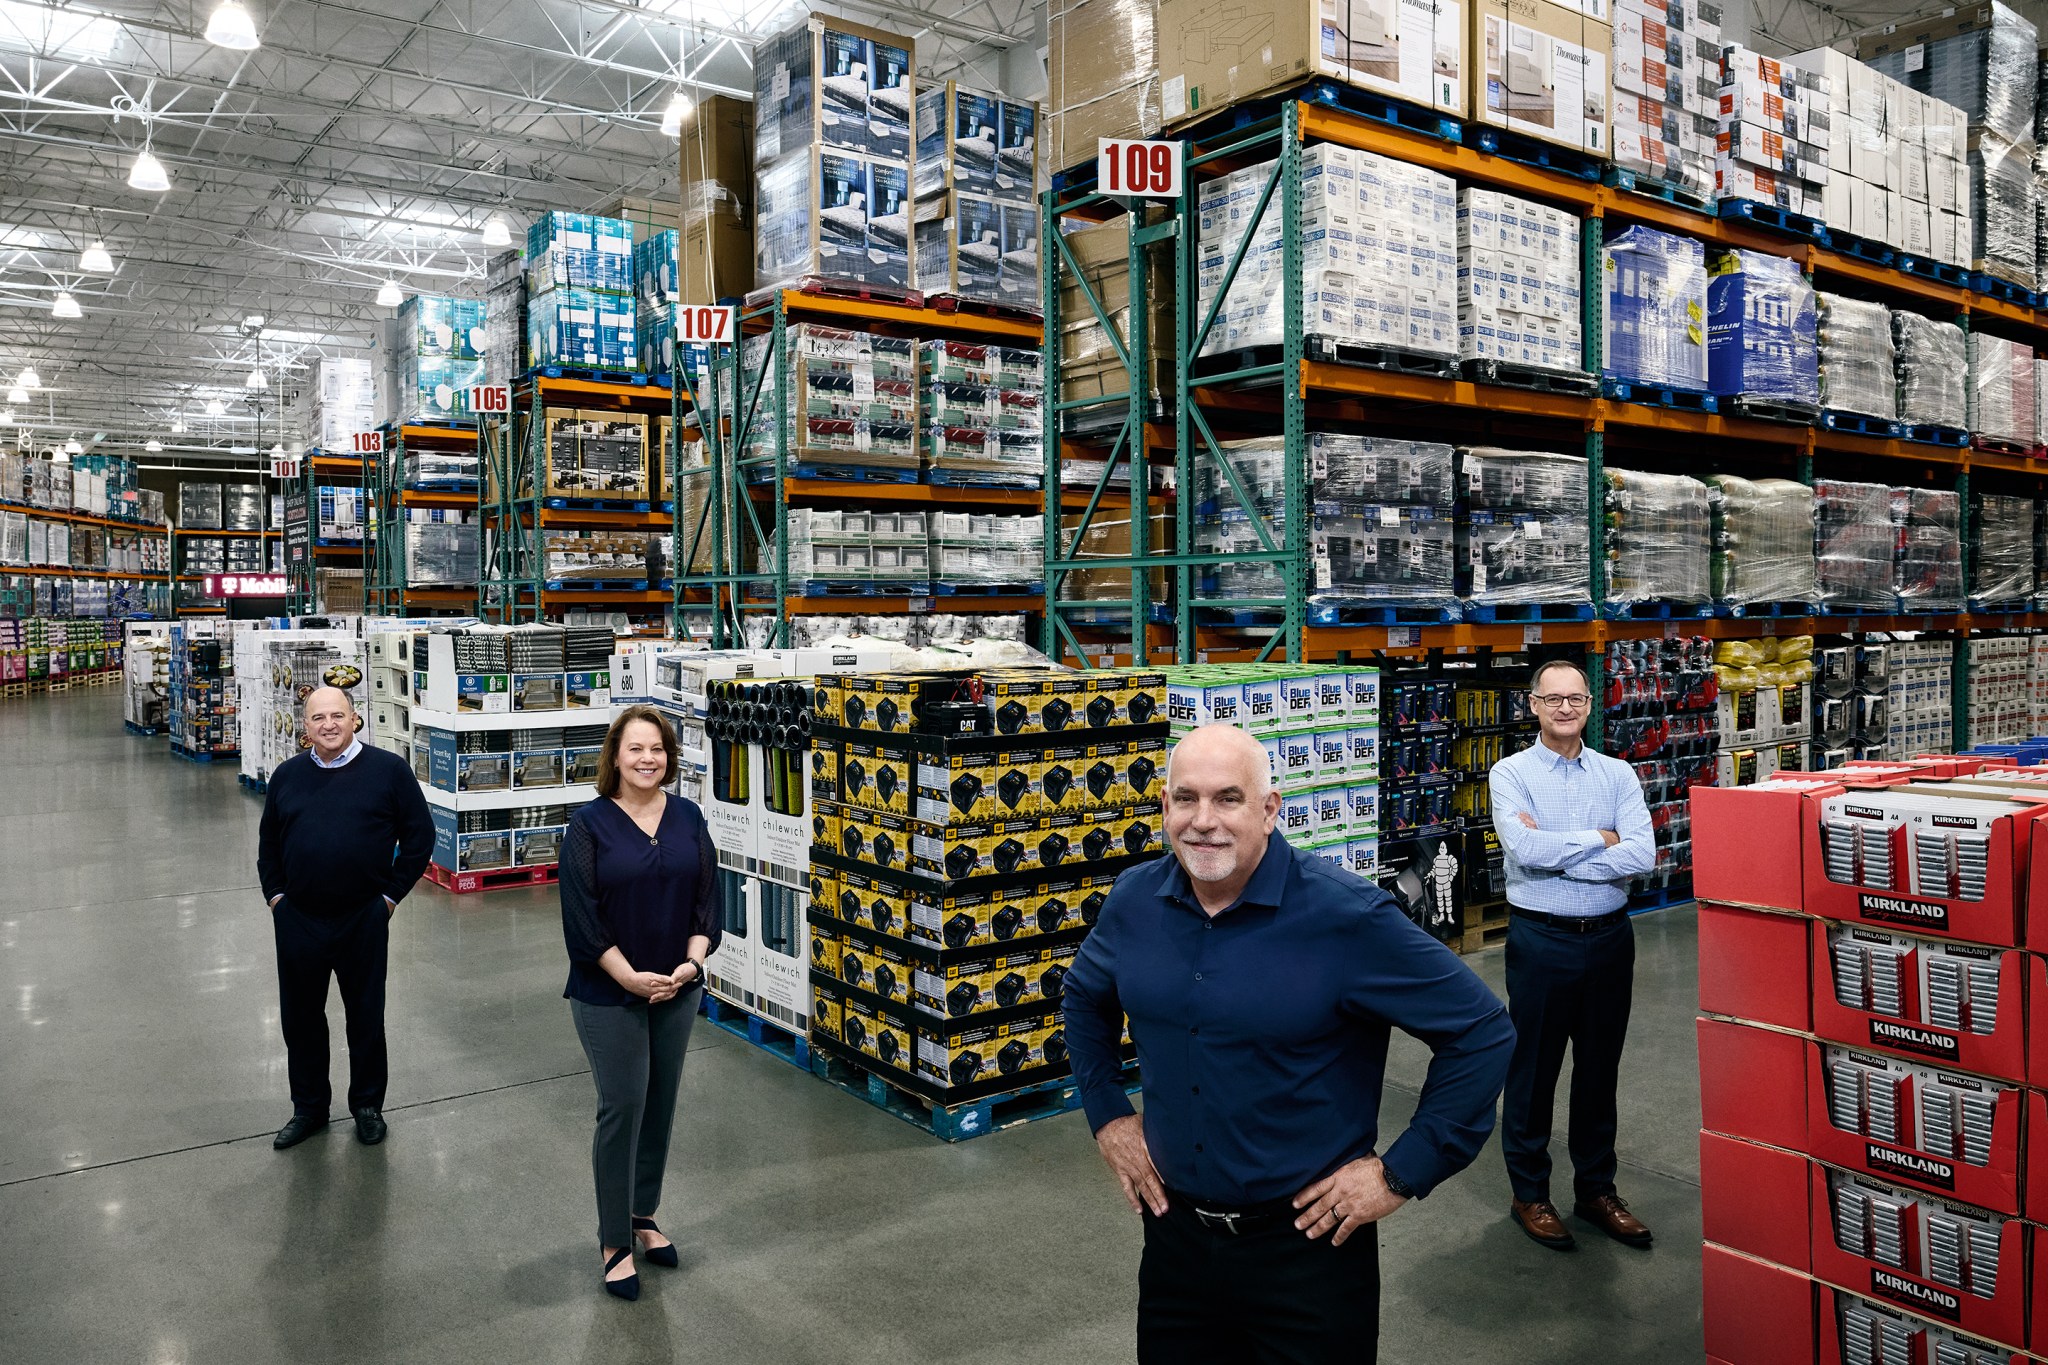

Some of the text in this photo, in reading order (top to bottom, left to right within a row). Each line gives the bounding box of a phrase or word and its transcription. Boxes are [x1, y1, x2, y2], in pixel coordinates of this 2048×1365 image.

[1105, 143, 1172, 192] 109
[683, 308, 728, 339] 107
[1708, 322, 1740, 331] CHELIN
[473, 386, 506, 410] 105
[353, 432, 381, 451] 103
[275, 461, 297, 476] 101
[621, 675, 634, 691] 680
[1322, 684, 1341, 693] Blue
[1356, 683, 1375, 692] Blue
[1253, 693, 1272, 703] Blue
[1290, 688, 1310, 698] Blue
[1356, 692, 1375, 703] DEF
[1169, 693, 1196, 707] Blue
[1214, 697, 1236, 707] Blue
[1290, 698, 1310, 709] DEF
[1322, 694, 1341, 705] DEF
[1169, 705, 1196, 720] DEF
[1214, 706, 1236, 719] DEF
[1253, 702, 1272, 715] DEF
[960, 720, 976, 731] CAT
[1323, 742, 1342, 752] Blue
[1355, 738, 1374, 747] Blue
[1289, 745, 1308, 756] Blue
[1355, 747, 1374, 758] DEF
[1289, 754, 1308, 767] DEF
[1323, 751, 1342, 763] DEF
[1322, 800, 1340, 810] Blue
[1356, 796, 1374, 806] Blue
[712, 807, 750, 825] chilewich
[1288, 805, 1308, 816] Blue
[1322, 808, 1340, 821] DEF
[1356, 805, 1374, 816] DEF
[1846, 806, 1882, 817] KIRKLAND
[1288, 815, 1308, 828] DEF
[1934, 816, 1976, 826] KIRKLAND
[762, 818, 804, 837] chilewich
[1484, 831, 1498, 842] Fan
[1356, 849, 1374, 859] Blue
[1356, 858, 1374, 870] DEF
[458, 882, 475, 890] PECO
[1863, 896, 1944, 918] KIRKLAND
[1854, 930, 1891, 942] KIRKLAND
[1947, 945, 1989, 956] KIRKLAND
[760, 954, 800, 979] chilewich
[1873, 1021, 1955, 1049] KIRKLAND
[1850, 1052, 1886, 1067] KIRKLAND
[1939, 1075, 1981, 1088] KIRKLAND
[1870, 1146, 1951, 1177] KIRKLAND
[1855, 1176, 1892, 1192] KIRKLAND
[1946, 1203, 1988, 1219] KIRKLAND
[1875, 1271, 1957, 1308] KIRKLAND
[1955, 1333, 1997, 1349] KIRKLAND
